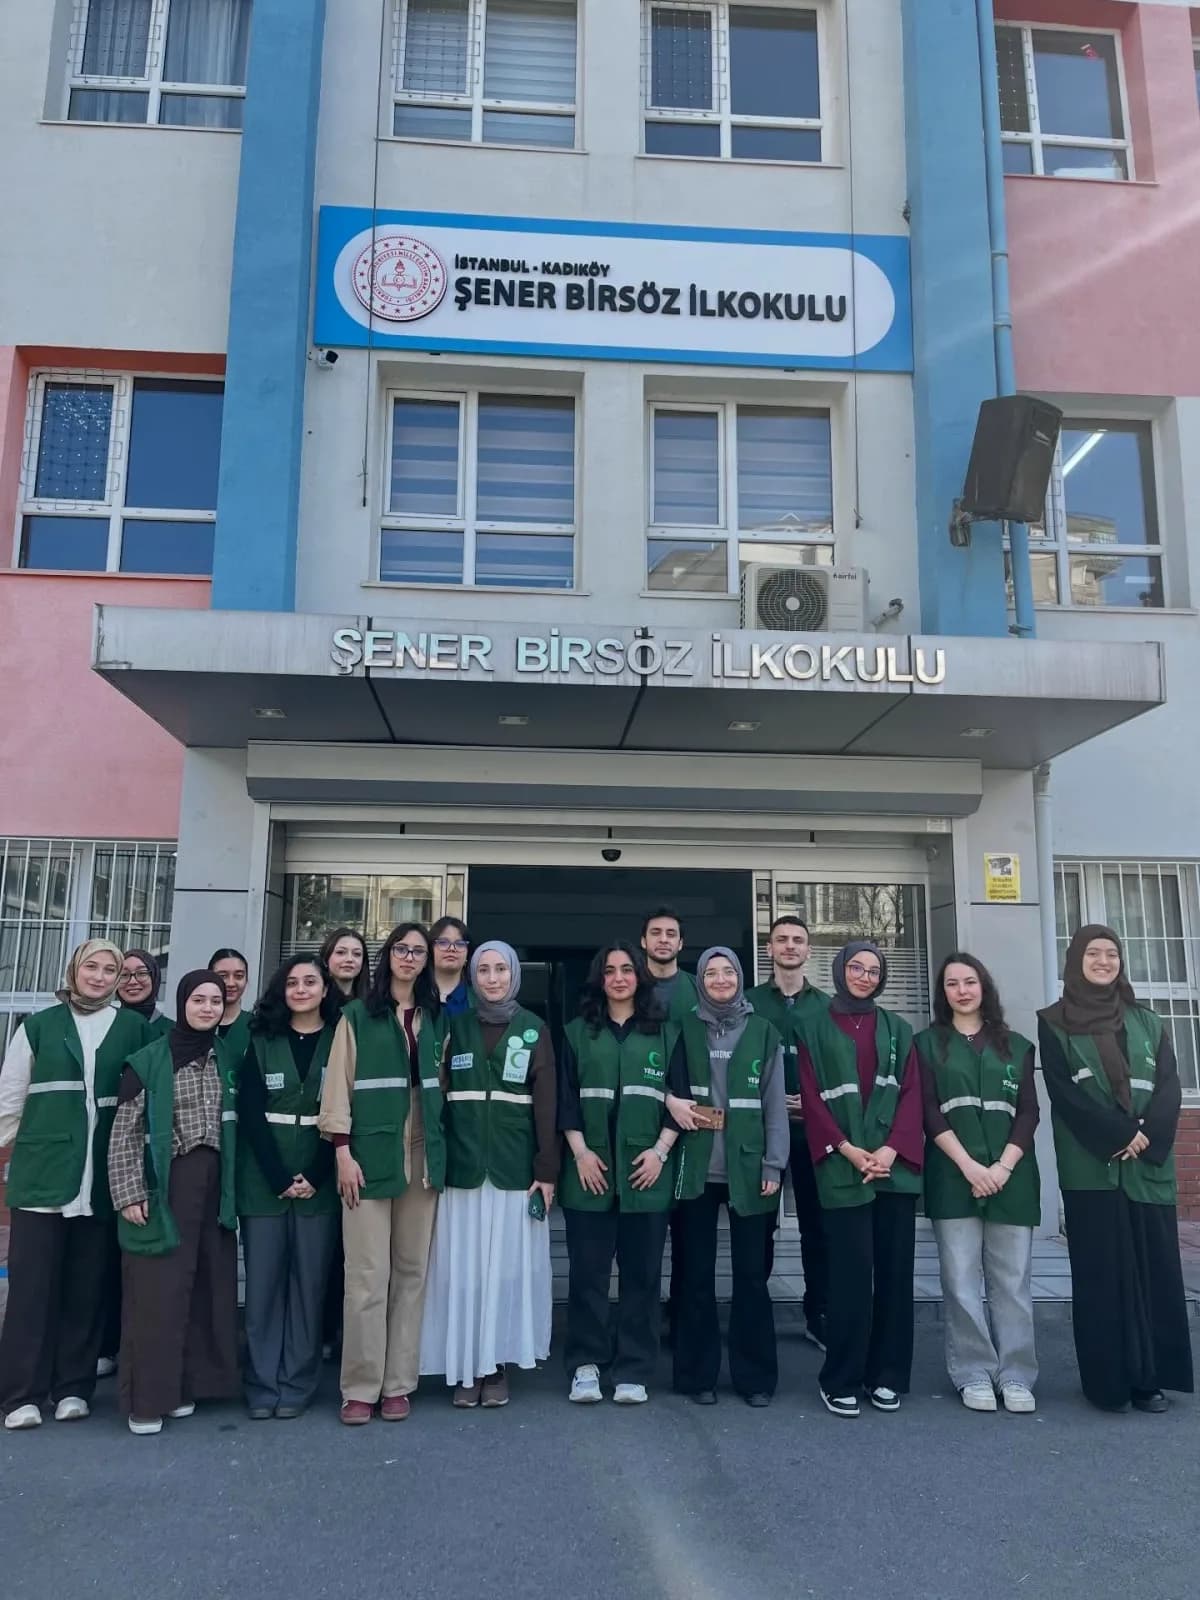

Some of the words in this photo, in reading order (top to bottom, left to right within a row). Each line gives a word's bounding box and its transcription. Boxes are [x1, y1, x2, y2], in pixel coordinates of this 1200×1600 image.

[454, 253, 530, 273] İSTANBUL
[541, 260, 611, 278] KADIKÖY
[455, 277, 556, 312] ŞENER
[565, 279, 681, 314] BİRSÖZ
[689, 283, 847, 322] İLKOKULU
[331, 628, 494, 674] ŞENER
[516, 627, 694, 677] BİRSÖZ
[711, 632, 946, 685] İLKOKULU
